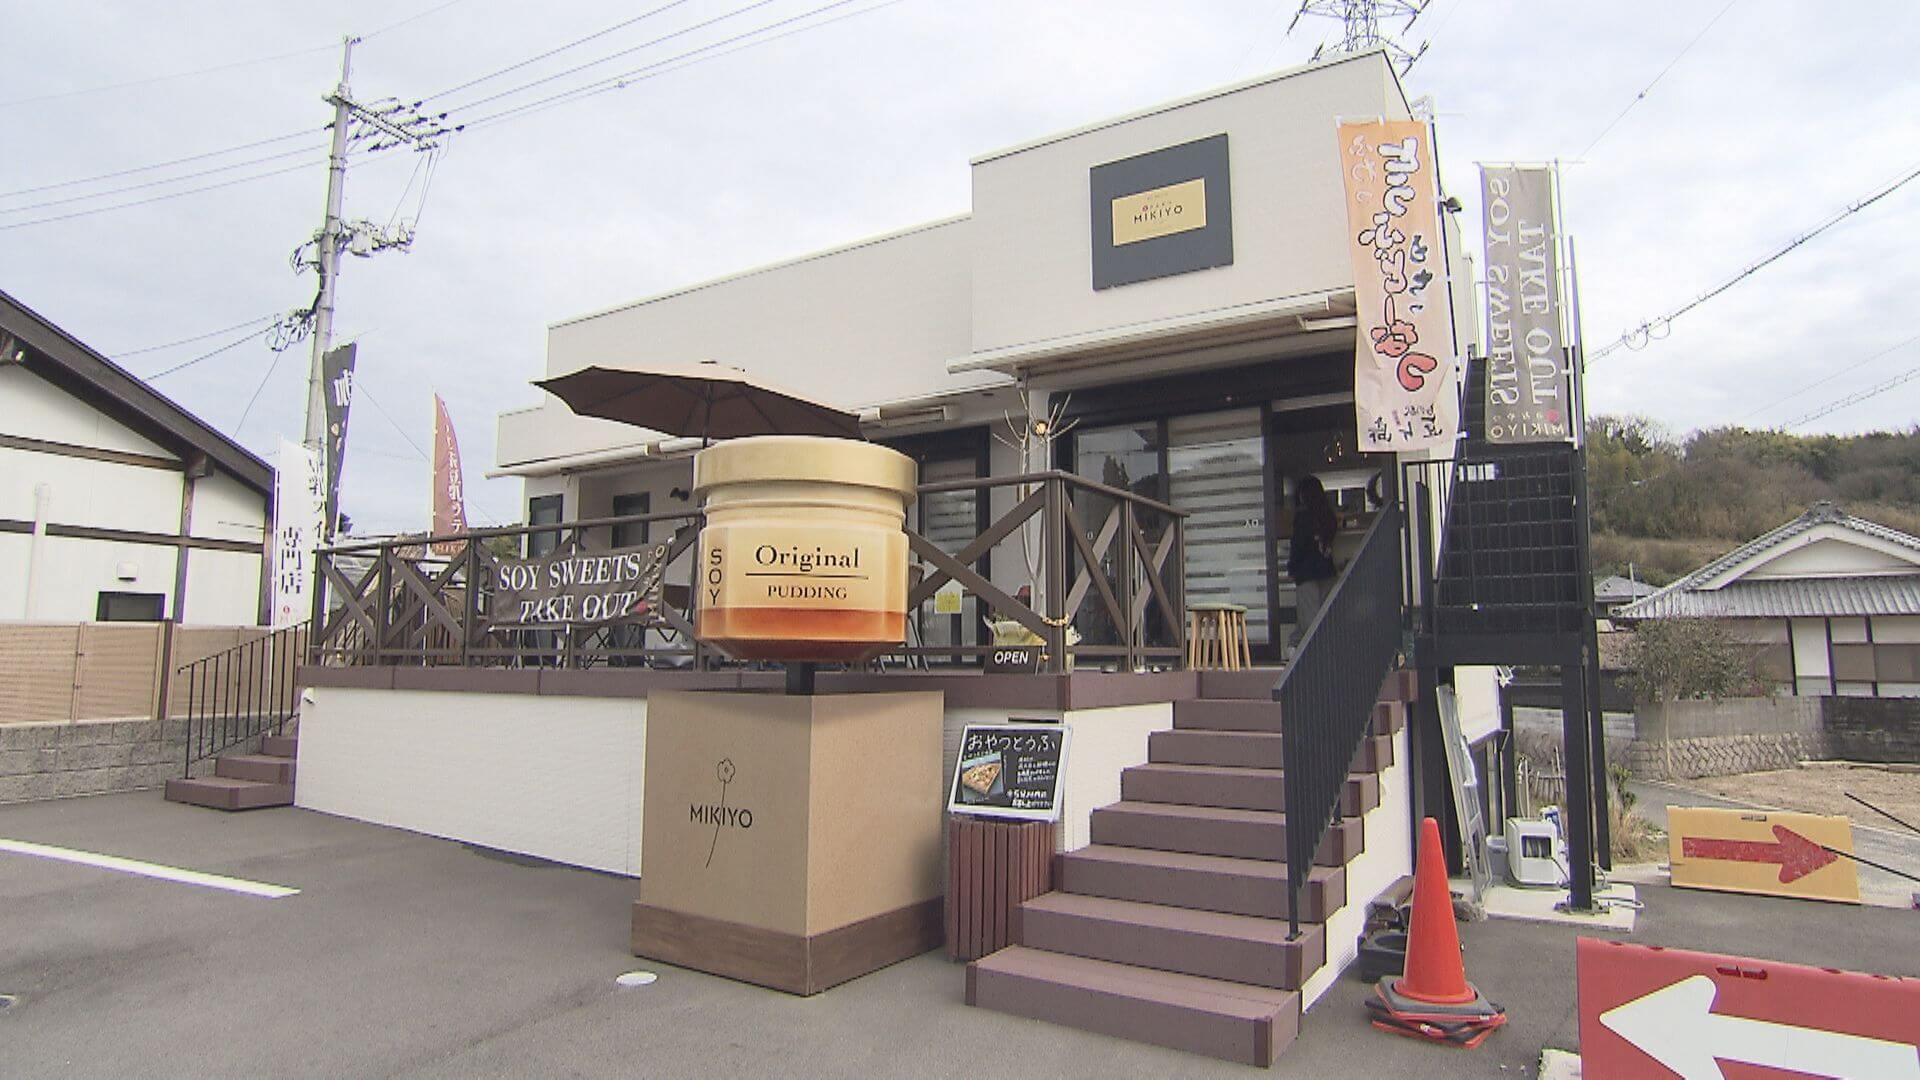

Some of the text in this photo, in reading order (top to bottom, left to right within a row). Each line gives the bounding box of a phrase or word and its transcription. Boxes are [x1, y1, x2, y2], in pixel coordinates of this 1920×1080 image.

[1134, 205, 1183, 224] MIKIYO
[755, 544, 860, 572] Original
[499, 564, 540, 591] SOY
[549, 552, 641, 588] SWEETS
[708, 548, 723, 606] SOY
[767, 585, 848, 600] PUDDING
[520, 591, 637, 624] TAKE OUT
[994, 651, 1029, 665] OPEN
[967, 733, 1056, 752] おやつとうふ
[690, 804, 753, 828] MIKIYO
